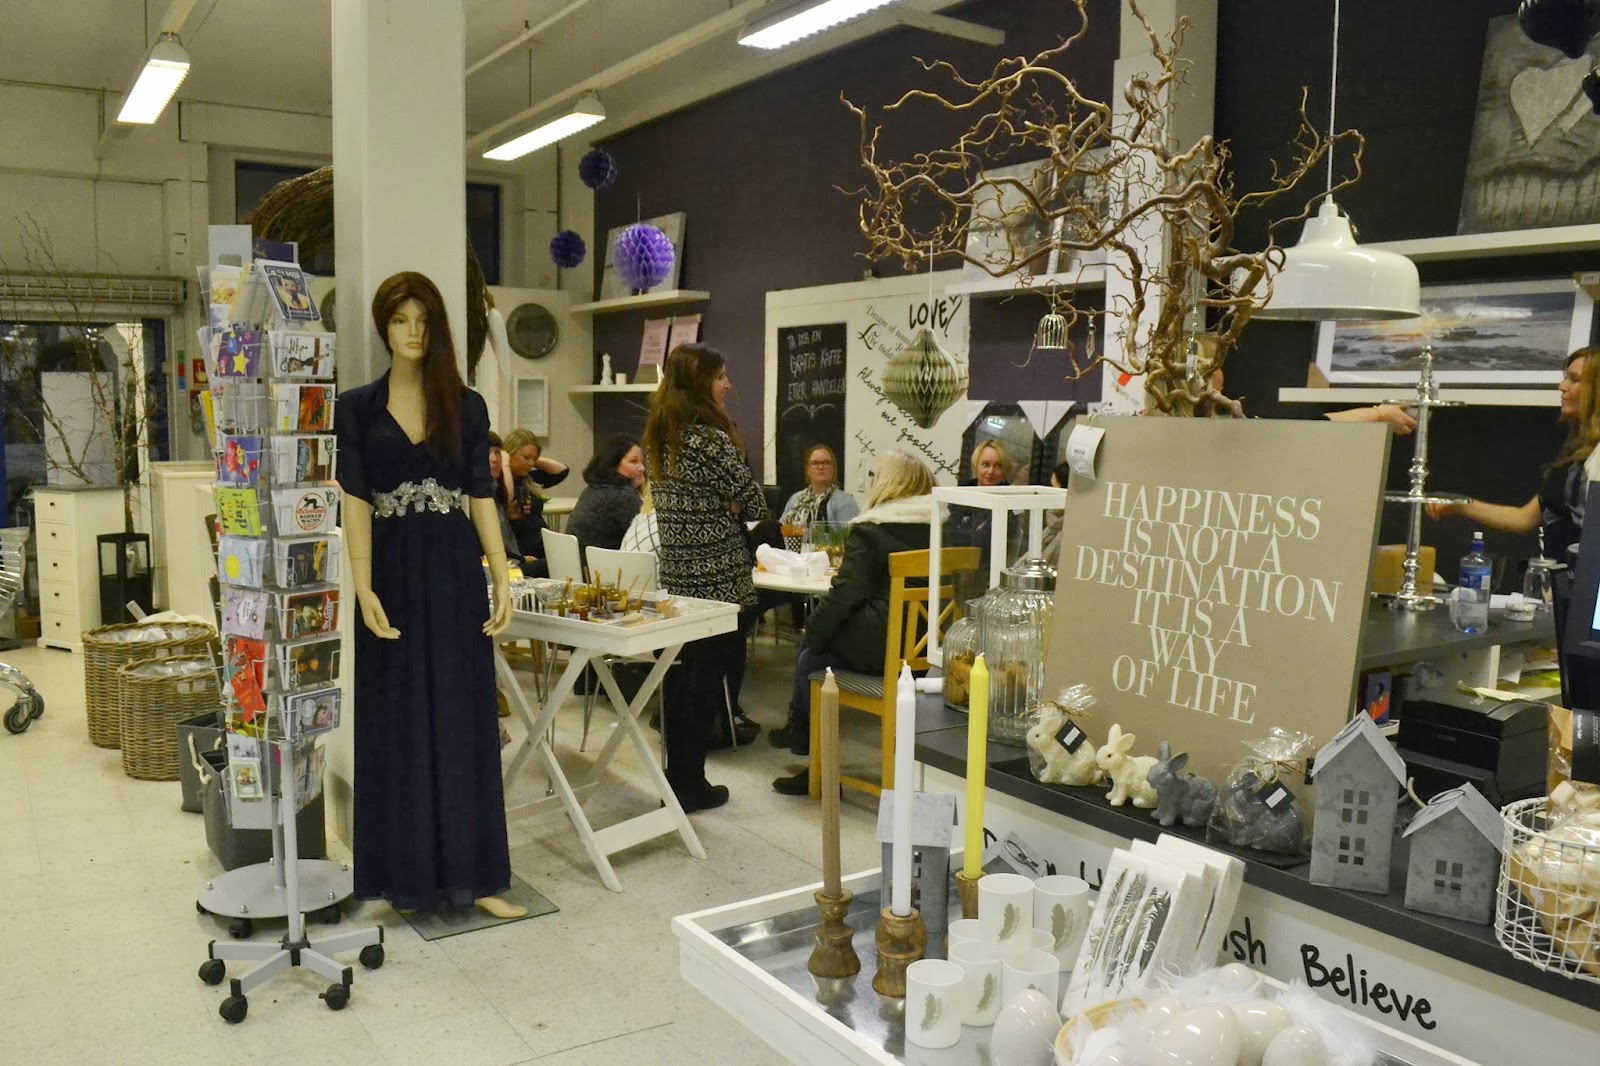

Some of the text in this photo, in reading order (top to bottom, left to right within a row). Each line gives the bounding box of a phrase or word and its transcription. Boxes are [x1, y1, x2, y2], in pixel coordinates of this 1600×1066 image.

[909, 298, 948, 330] LOVE
[878, 343, 894, 359] toda
[855, 429, 876, 457] Life
[1101, 481, 1322, 540] HAPPINESS
[1121, 516, 1285, 576] IS NOT A
[1073, 545, 1343, 624] DESTINATION
[1130, 588, 1252, 648] IT IS A
[1148, 625, 1228, 677] WAY
[1112, 654, 1257, 725] OF LIFE
[1301, 943, 1437, 1030] Believe
